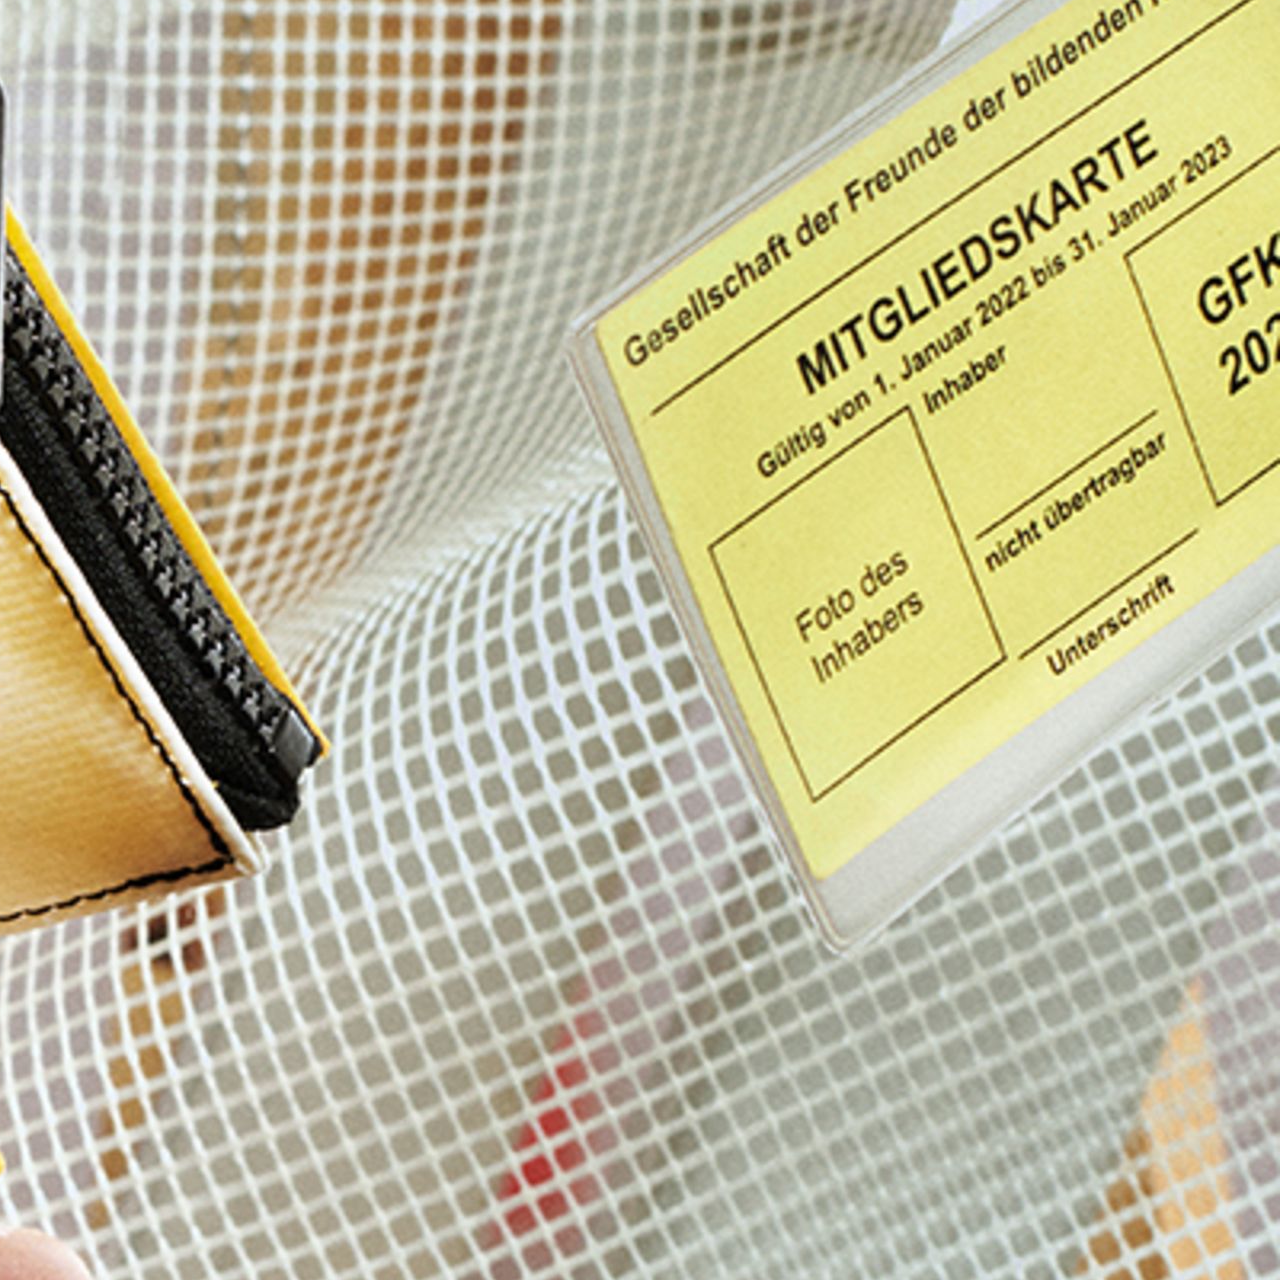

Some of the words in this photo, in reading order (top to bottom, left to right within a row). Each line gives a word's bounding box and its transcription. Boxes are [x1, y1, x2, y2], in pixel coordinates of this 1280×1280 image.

[624, 234, 791, 366] Gesellschaft
[795, 201, 838, 247] der
[843, 124, 957, 212] Freunde
[962, 87, 1005, 132] der
[795, 119, 1158, 395] MITGLIEDSKARTE
[756, 421, 826, 478] Gültig
[827, 389, 871, 427] von
[873, 372, 896, 395] 1.
[900, 316, 972, 381] Januar
[974, 275, 1029, 327] 2022
[1029, 254, 1066, 288] bis
[1067, 229, 1102, 262] 31.
[1107, 175, 1176, 237] Januar
[1180, 135, 1231, 184] 2023
[922, 345, 1005, 414] Inhaber
[984, 520, 1042, 571] nicht
[1043, 432, 1165, 530] übertragbar
[794, 588, 855, 642] Foto
[859, 551, 908, 597] des
[810, 591, 923, 682] Inhabers
[1046, 574, 1174, 675] Unterschrift
